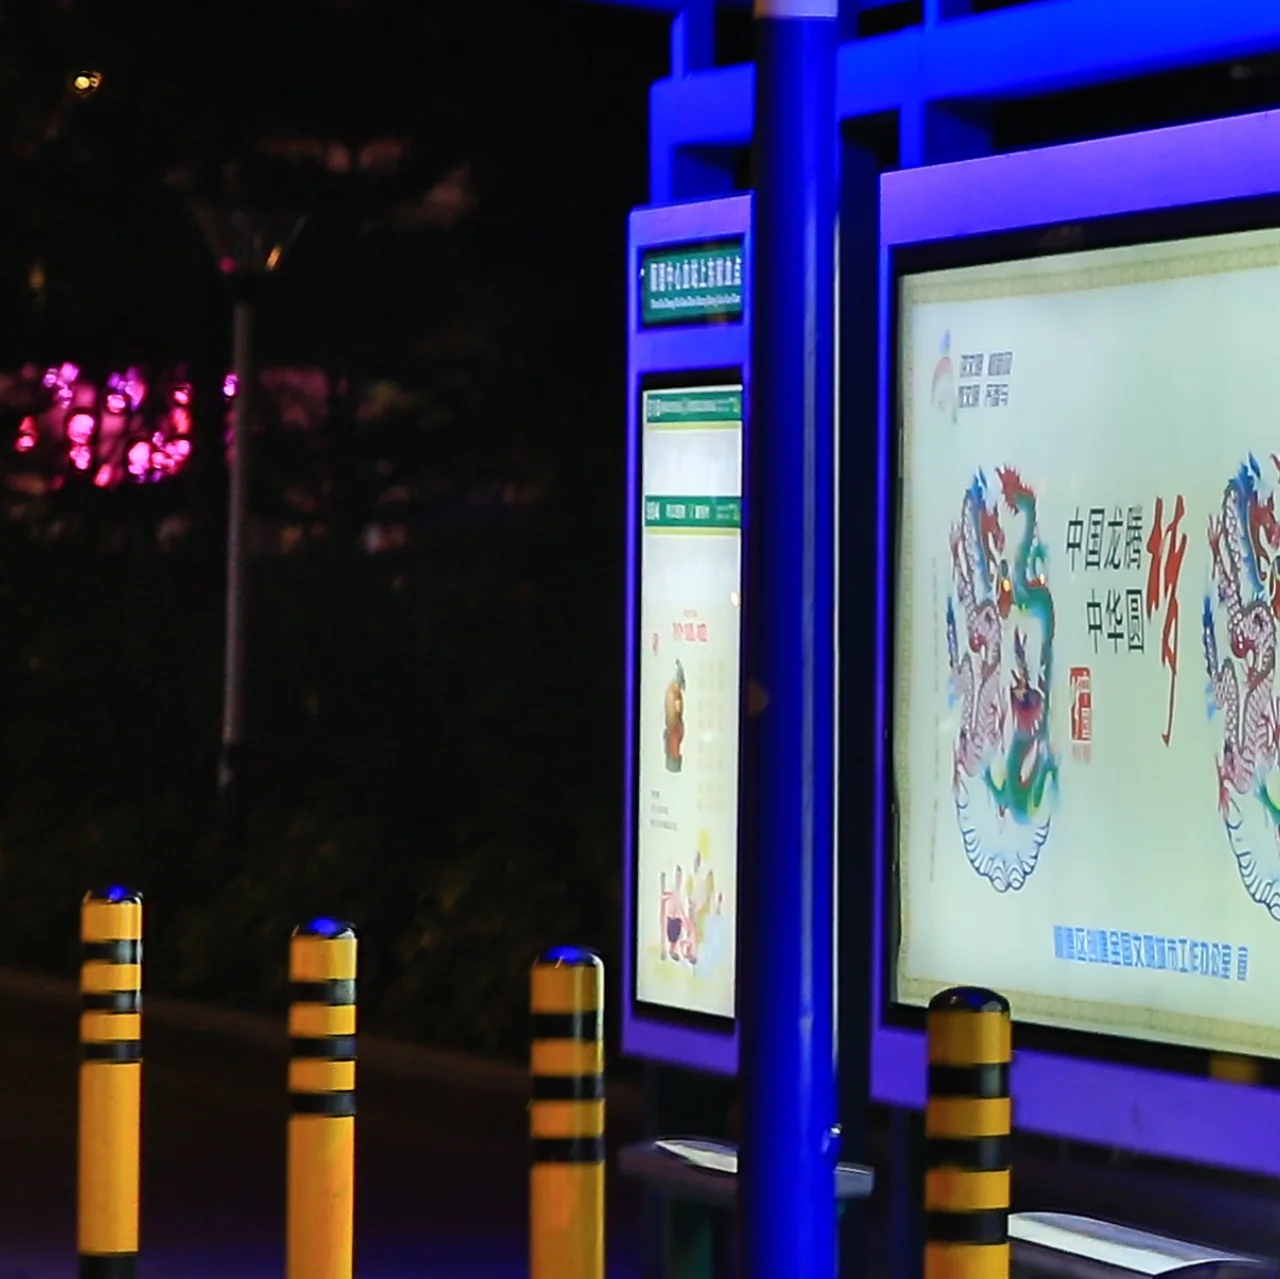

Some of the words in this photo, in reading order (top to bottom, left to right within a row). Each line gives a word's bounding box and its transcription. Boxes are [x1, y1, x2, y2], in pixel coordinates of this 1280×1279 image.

[1066, 504, 1144, 572] 中国龙腾
[1086, 587, 1145, 654] 中华圆
